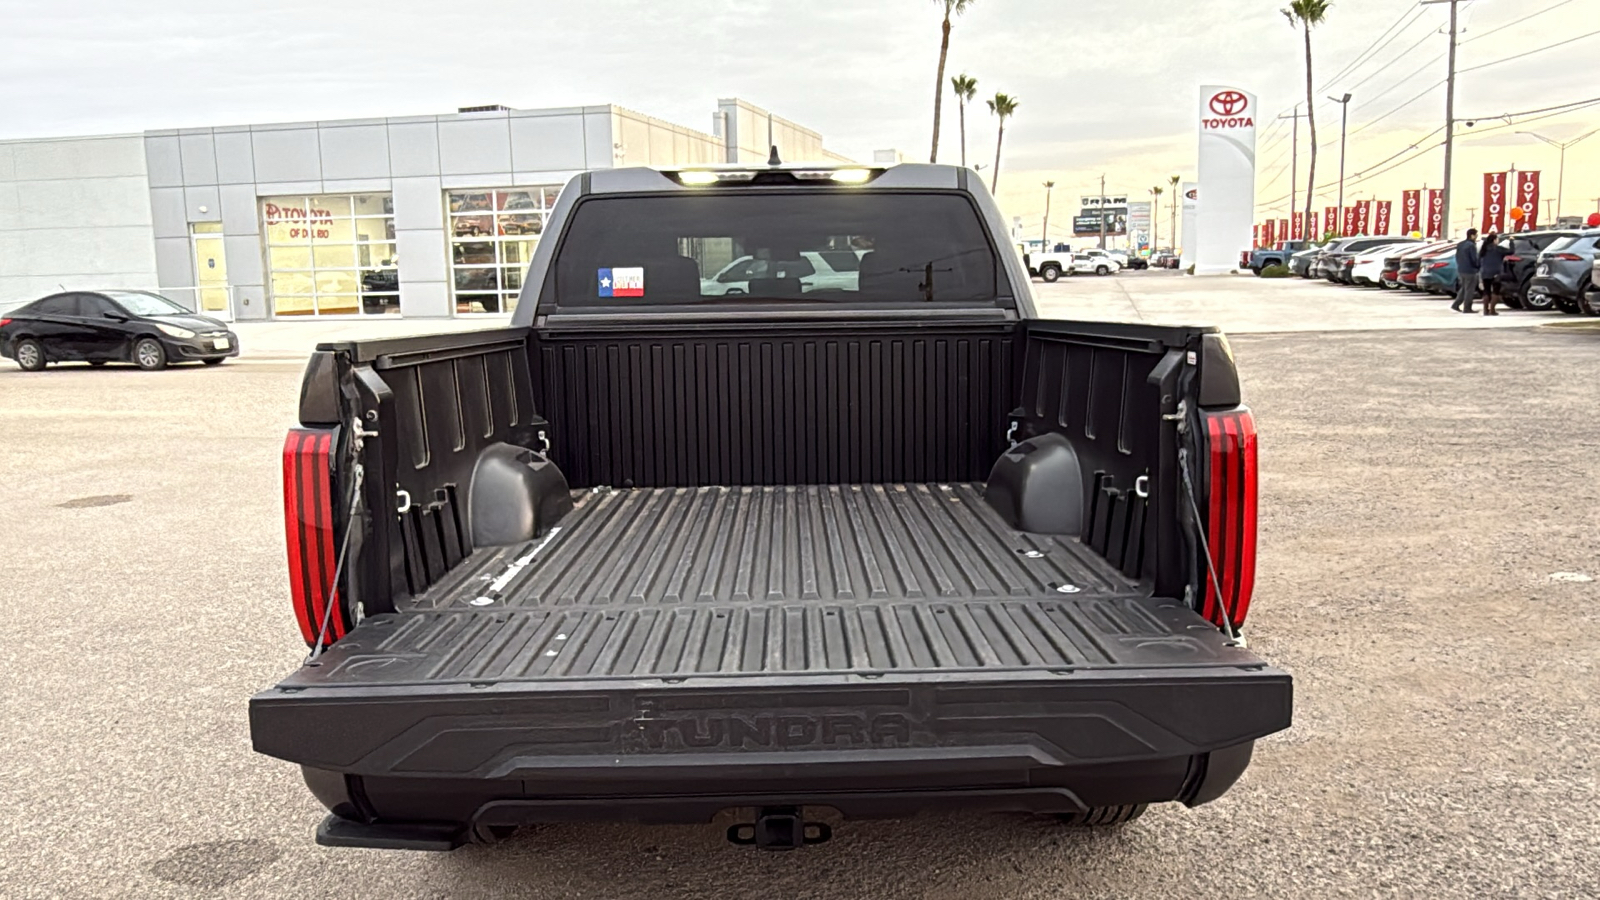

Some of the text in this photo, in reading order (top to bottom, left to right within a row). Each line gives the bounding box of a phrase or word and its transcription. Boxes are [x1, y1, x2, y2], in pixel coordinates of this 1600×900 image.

[1202, 117, 1253, 129] TOYOTA
[282, 208, 333, 225] TOYOTA
[1357, 201, 1366, 233] TOYOT
[1379, 201, 1388, 234] TOYOT
[1431, 190, 1442, 237] TOYOTA
[1488, 173, 1501, 234] TOYOTA
[1521, 172, 1534, 231] TOYOTA
[289, 228, 300, 238] OF
[302, 228, 315, 238] DL
[1346, 207, 1354, 236] TOYOT
[633, 712, 911, 749] TUNDRA
